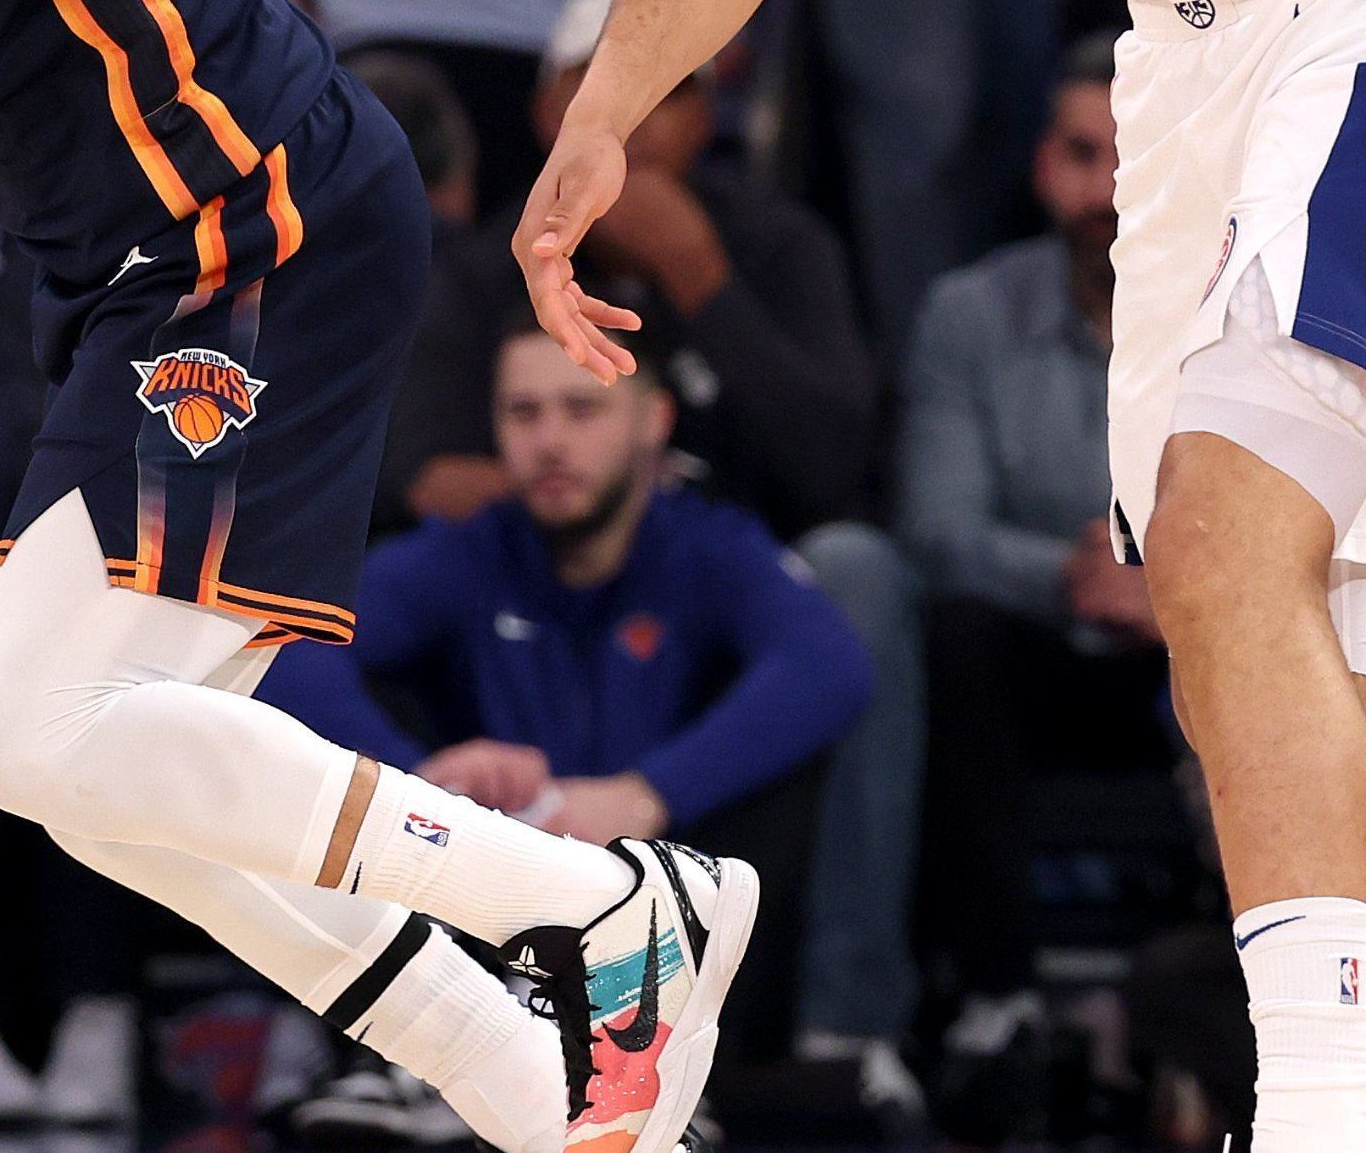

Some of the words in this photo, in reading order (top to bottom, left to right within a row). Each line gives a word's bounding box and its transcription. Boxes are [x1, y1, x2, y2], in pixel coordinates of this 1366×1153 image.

[180, 351, 202, 362] NEW
[203, 352, 227, 367] YORK
[141, 356, 253, 416] KNICKS
